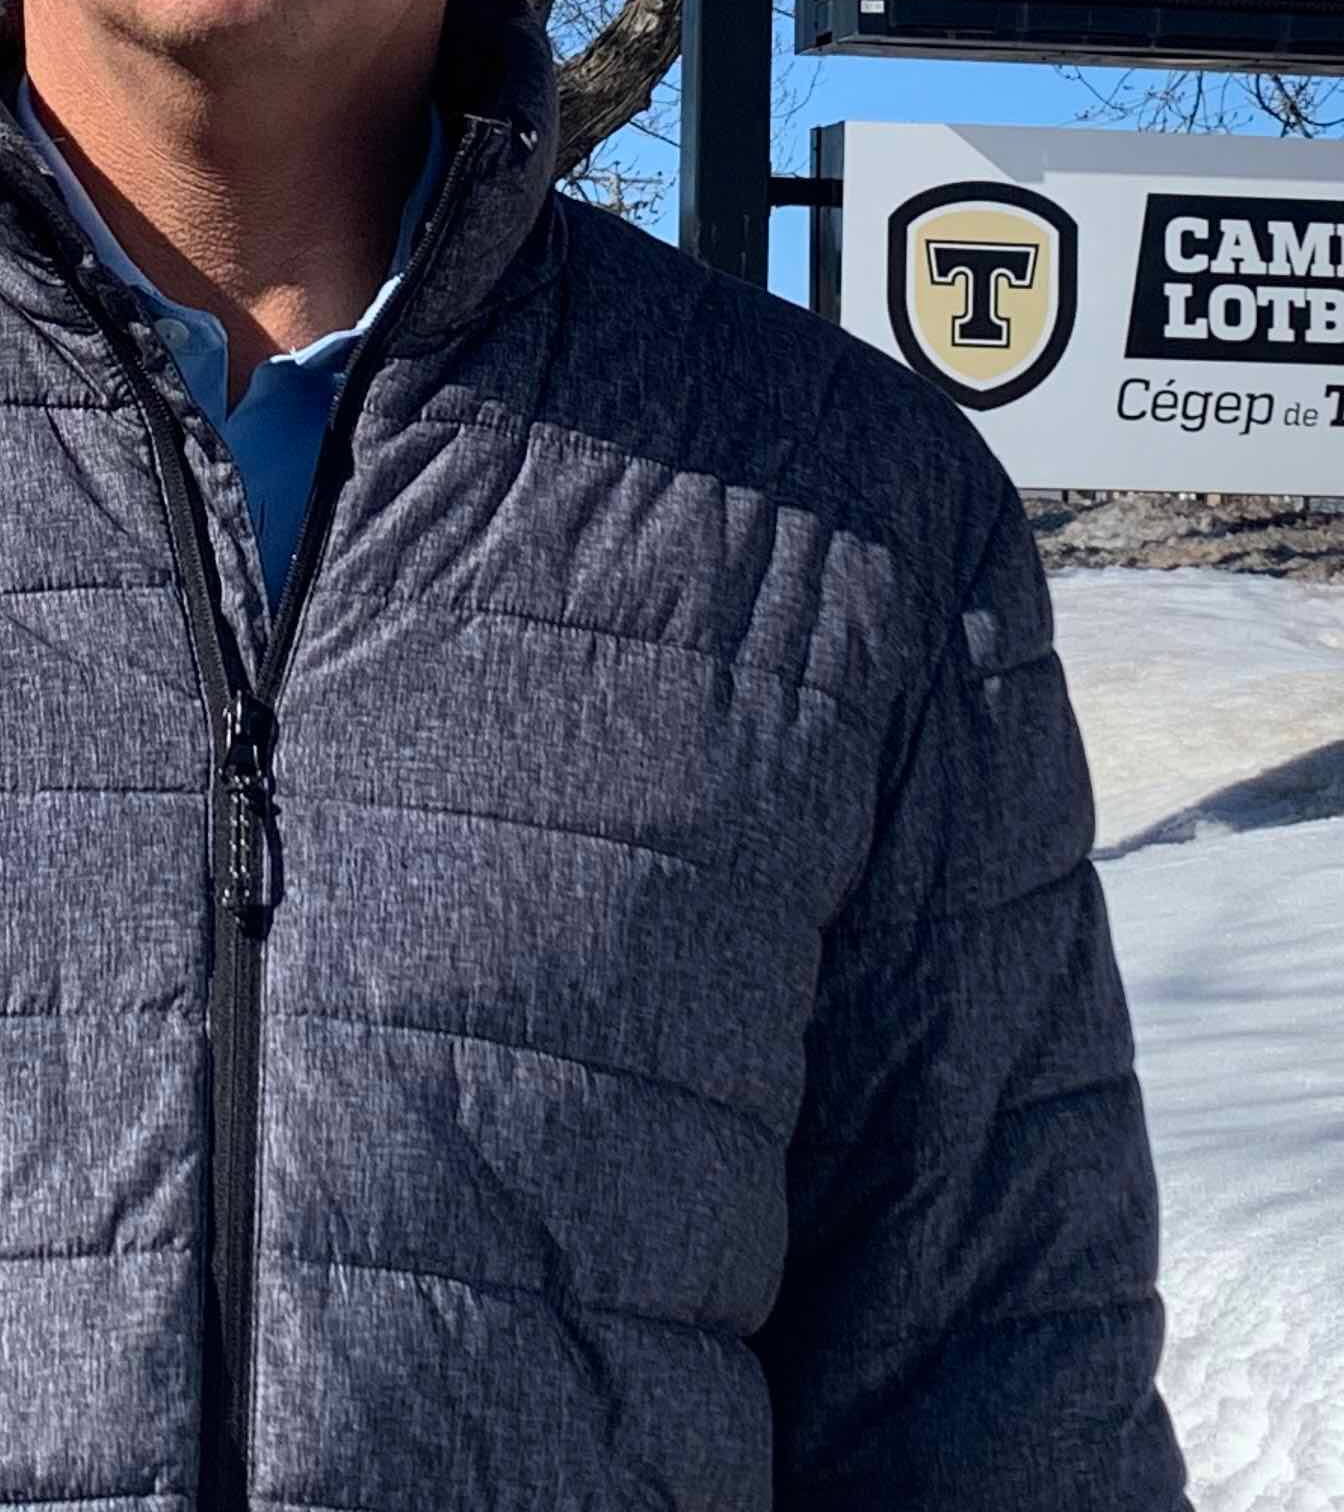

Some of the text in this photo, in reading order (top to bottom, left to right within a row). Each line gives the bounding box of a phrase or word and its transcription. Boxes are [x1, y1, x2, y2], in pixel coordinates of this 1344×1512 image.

[924, 238, 1040, 347] T
[1116, 377, 1275, 436] Cégep
[1283, 402, 1319, 428] de
